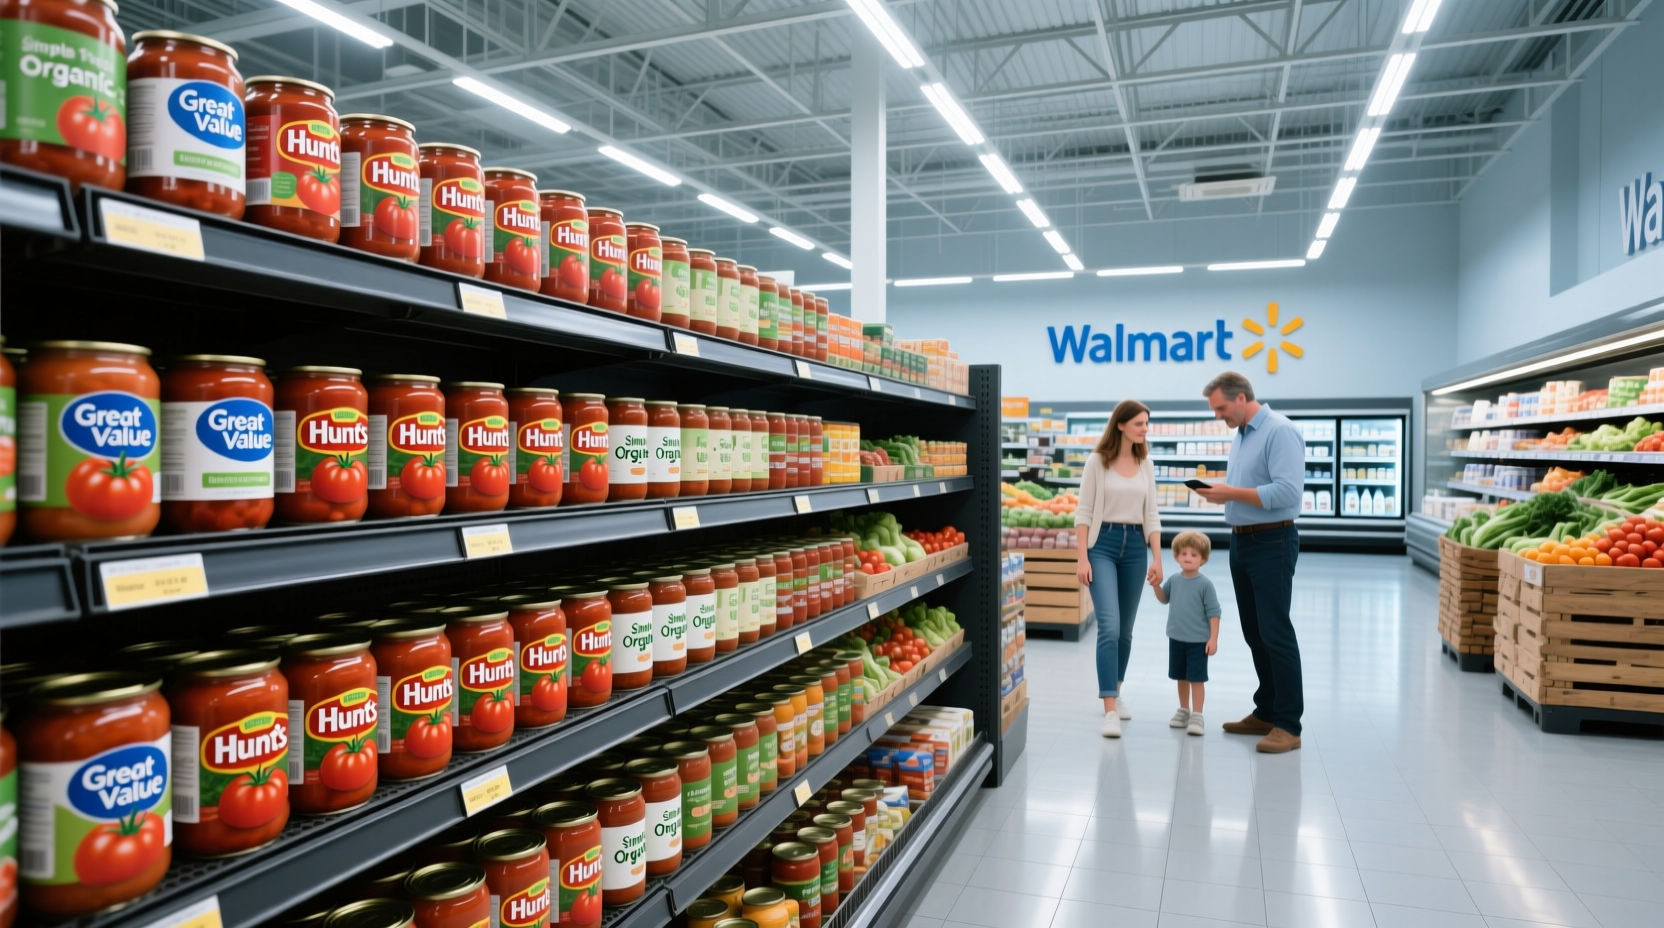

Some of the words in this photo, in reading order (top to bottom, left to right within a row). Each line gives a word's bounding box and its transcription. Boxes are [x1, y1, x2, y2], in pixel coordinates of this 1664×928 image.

[20, 54, 117, 98] Organic
[179, 89, 235, 120] Great
[194, 112, 242, 142] Value
[1047, 319, 1234, 363] Walmart
[74, 402, 142, 427] Great
[208, 408, 265, 431] Great
[91, 426, 152, 448] Value
[222, 430, 272, 450] Value
[214, 723, 288, 764] Hunt's
[82, 755, 155, 791] Great
[98, 775, 163, 810] Value
